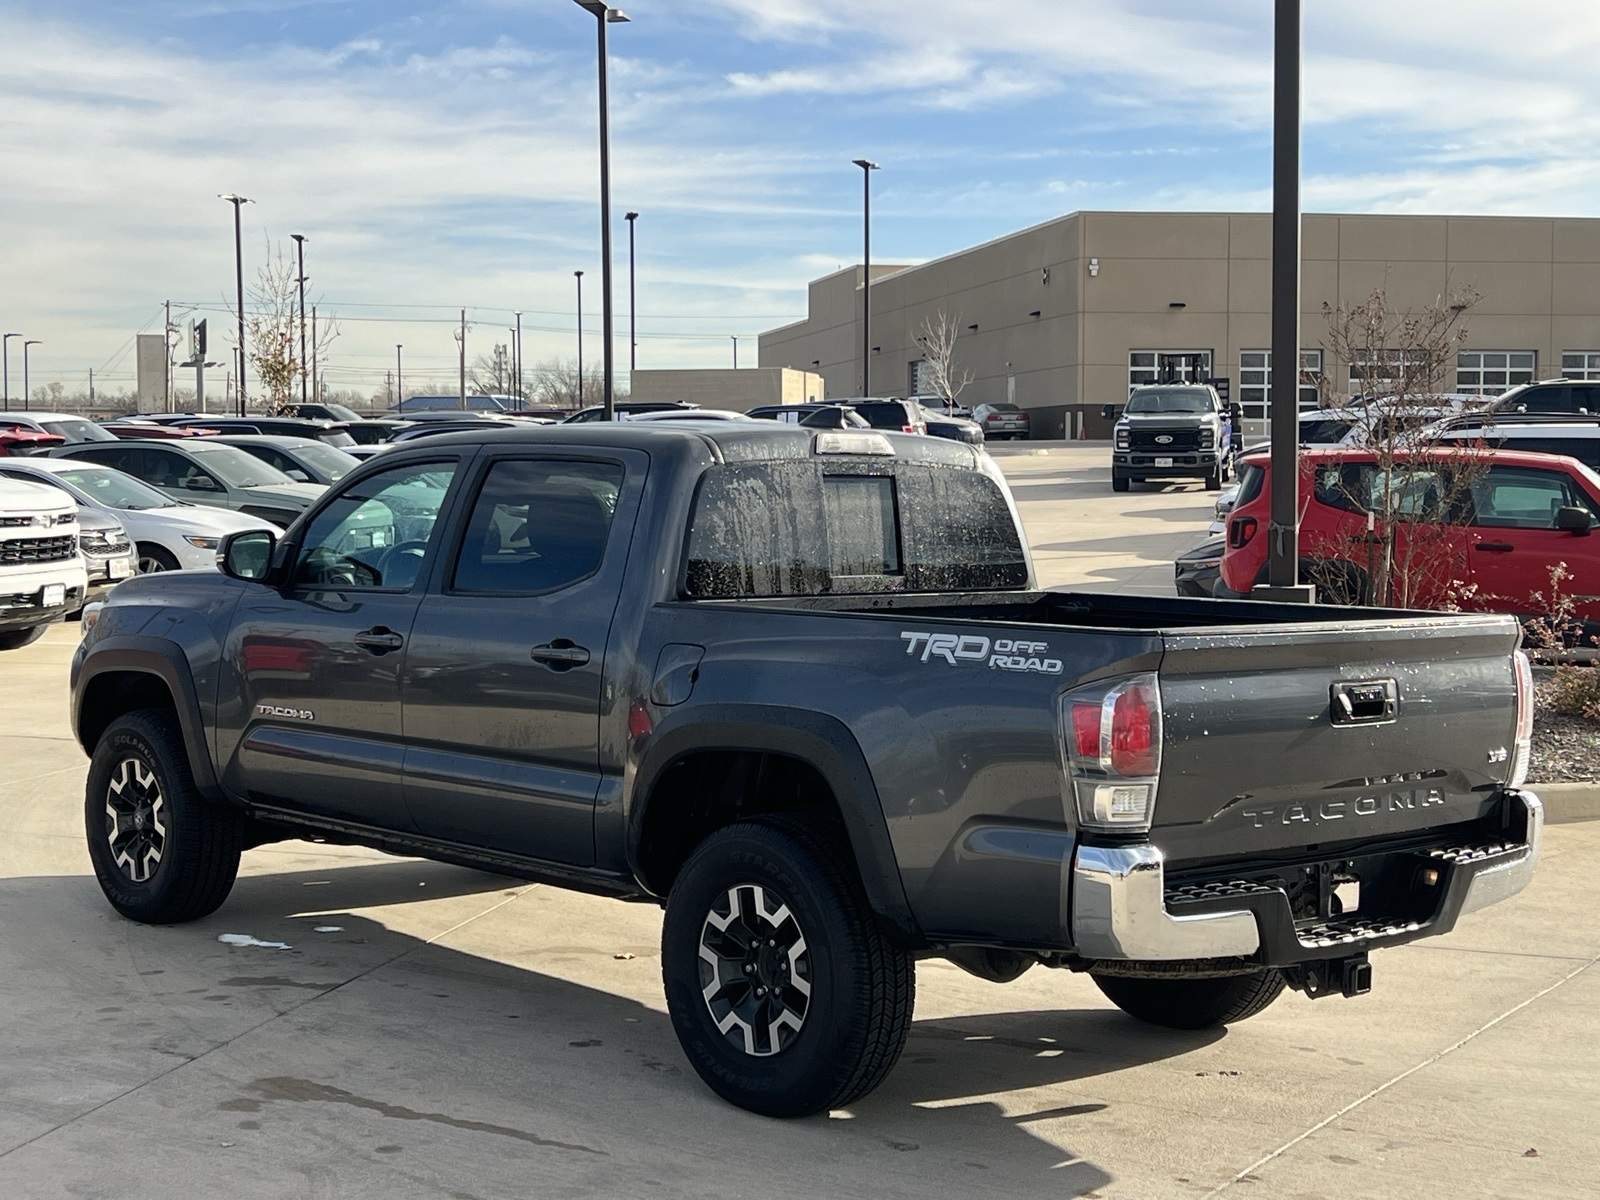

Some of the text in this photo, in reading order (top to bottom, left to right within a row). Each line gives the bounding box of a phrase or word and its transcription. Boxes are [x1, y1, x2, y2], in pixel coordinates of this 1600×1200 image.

[901, 632, 1049, 666] TRD OFF
[988, 655, 1064, 675] ROAD
[256, 704, 315, 720] TACOMA
[1242, 786, 1445, 829] TACOMA
